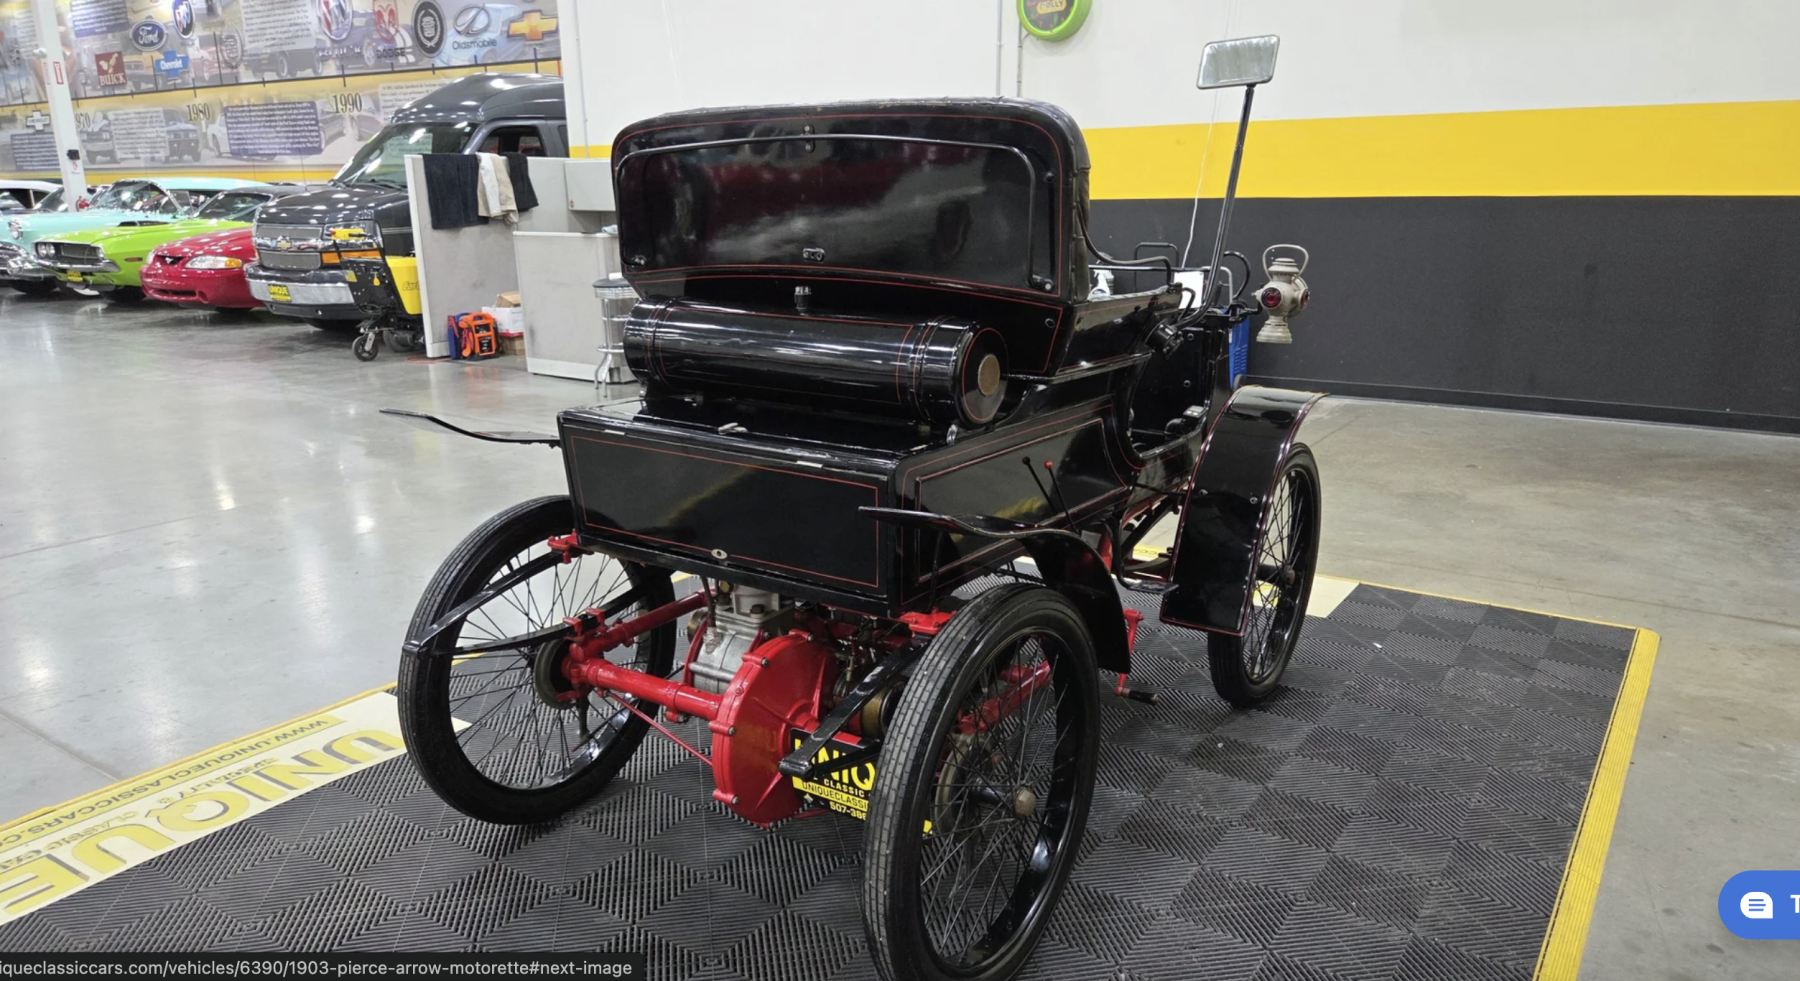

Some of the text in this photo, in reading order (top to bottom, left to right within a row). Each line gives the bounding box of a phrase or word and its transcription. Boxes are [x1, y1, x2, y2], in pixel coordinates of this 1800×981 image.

[138, 26, 160, 44] Ford
[452, 38, 498, 50] Oldsmobile
[376, 47, 406, 59] DODGE
[160, 59, 183, 70] Chevrolet
[98, 73, 127, 86] BUICK
[333, 93, 363, 114] 1990
[75, 112, 91, 128] 970
[186, 103, 211, 122] 1980
[823, 778, 866, 798] CLASSIC
[0, 731, 404, 916] UNIQUE
